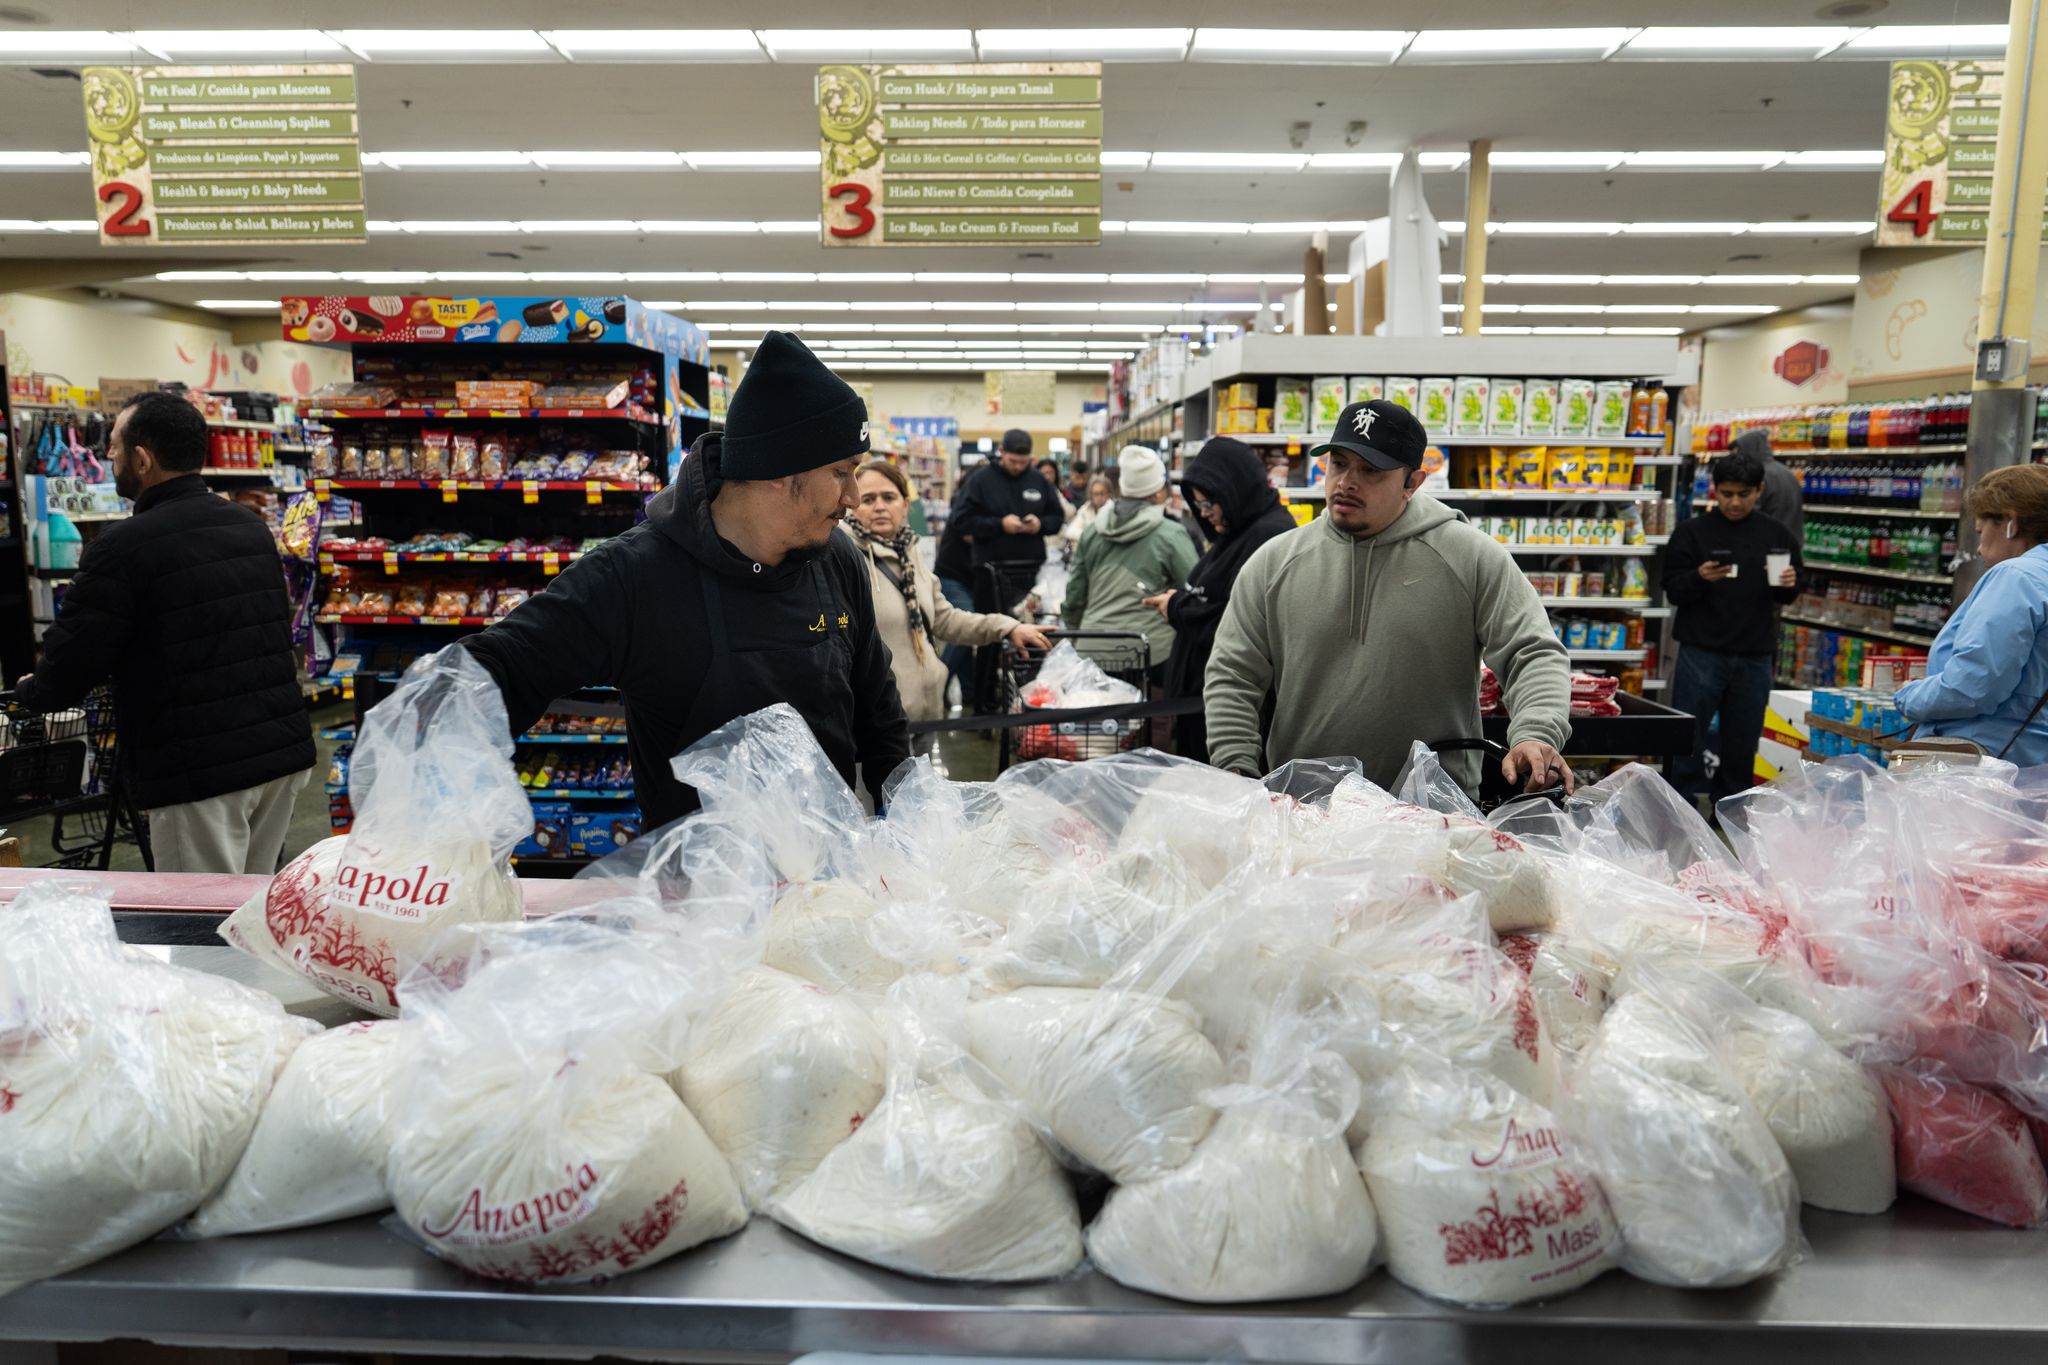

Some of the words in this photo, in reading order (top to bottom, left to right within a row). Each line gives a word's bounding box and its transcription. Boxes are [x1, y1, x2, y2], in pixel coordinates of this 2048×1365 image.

[150, 85, 168, 96] Pet
[171, 84, 197, 96] Food
[208, 84, 250, 96] Comida
[253, 87, 278, 98] para
[280, 84, 331, 96] Mascotas
[885, 84, 912, 95] Corn
[956, 83, 988, 97] Hojas
[991, 86, 1016, 97] para
[1019, 83, 1054, 95] Tamal
[180, 117, 217, 129] Bleach
[219, 117, 228, 129] &
[231, 116, 287, 131] Cleanning
[289, 116, 331, 131] Suplies
[890, 117, 930, 132] Baking
[932, 117, 967, 129] Needs
[981, 117, 1008, 129] Todo
[1011, 120, 1036, 131] para
[1039, 117, 1086, 129] Hornear
[1956, 116, 1978, 125] Cold
[156, 152, 201, 163] Productos
[203, 152, 216, 163] de
[264, 151, 290, 164] Papel
[291, 154, 298, 164] y
[299, 151, 340, 164] Juguetes
[889, 153, 911, 164] Cold
[914, 153, 922, 164] &
[923, 153, 941, 164] Hot
[943, 153, 974, 164] Cereal
[976, 153, 984, 164] &
[1022, 153, 1063, 164] Cereales
[1065, 153, 1073, 164] &
[159, 184, 197, 197] Health
[200, 184, 208, 197] &
[211, 184, 249, 199] Beauty
[252, 184, 260, 196] &
[264, 183, 290, 198] Baby
[293, 183, 327, 196] Needs
[889, 186, 921, 198] Hielo
[923, 186, 956, 198] Nieve
[959, 186, 967, 198] &
[970, 186, 1013, 198] Comida
[1015, 186, 1074, 200] Congelada
[1954, 184, 1993, 198] Papita
[99, 181, 151, 236] 2
[829, 182, 875, 238] 3
[1887, 180, 1938, 238] 4
[164, 217, 218, 230] Productos
[219, 217, 233, 230] de
[271, 217, 311, 230] Belleza
[313, 220, 320, 232] y
[323, 217, 354, 230] Bebes
[889, 222, 907, 233] Ice
[940, 222, 957, 233] Ice
[959, 222, 996, 233] Cream
[999, 222, 1008, 233] &
[1011, 222, 1050, 233] Frozen
[1052, 222, 1079, 233] Food
[1942, 219, 1969, 230] Beer
[1971, 219, 1981, 230] &
[437, 304, 467, 314] TASTE
[337, 864, 451, 907] apola
[394, 905, 420, 918] 1961
